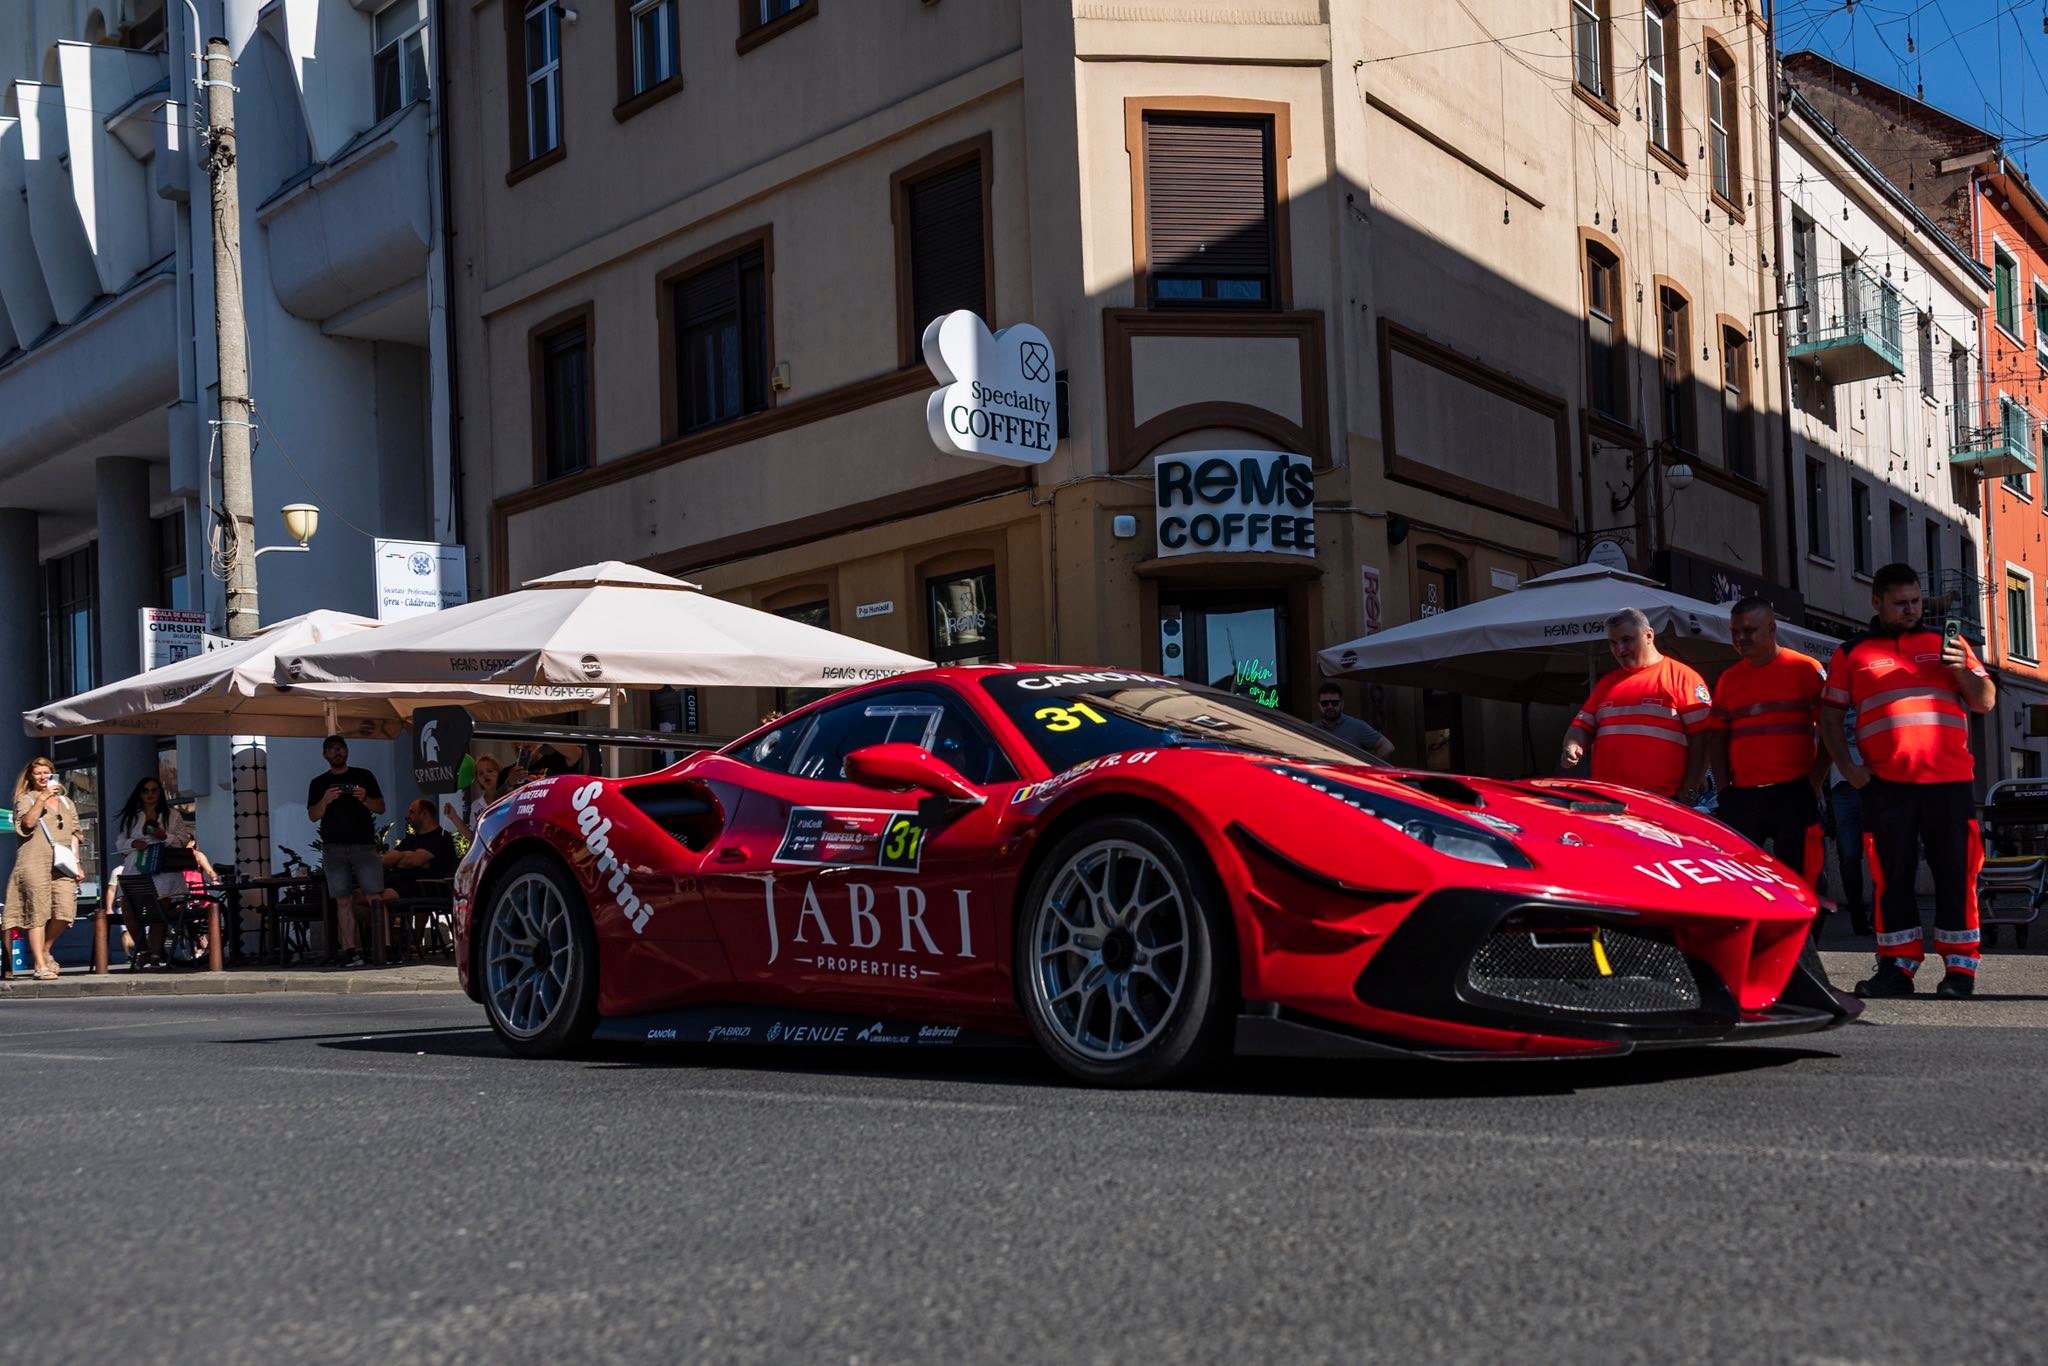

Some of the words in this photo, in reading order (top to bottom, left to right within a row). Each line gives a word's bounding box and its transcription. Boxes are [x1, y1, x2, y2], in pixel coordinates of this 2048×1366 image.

[972, 381, 1051, 421] Specialty
[951, 405, 1051, 451] COFFEE
[1159, 513, 1316, 549] COFFEE
[1016, 671, 1180, 690] CANOVA
[687, 695, 697, 726] COFFEE
[1034, 703, 1108, 732] 31
[1127, 751, 1158, 764] 01
[414, 765, 454, 783] SPARTAN
[886, 820, 922, 860] 31
[572, 781, 655, 934] Sabrini
[1633, 858, 1800, 891] VENUE
[763, 873, 976, 965] JABRI
[817, 956, 918, 979] PROPERTIES
[647, 1028, 677, 1039] CANOVA
[783, 1026, 848, 1042] VENUE
[918, 1025, 961, 1038] Sabrini
